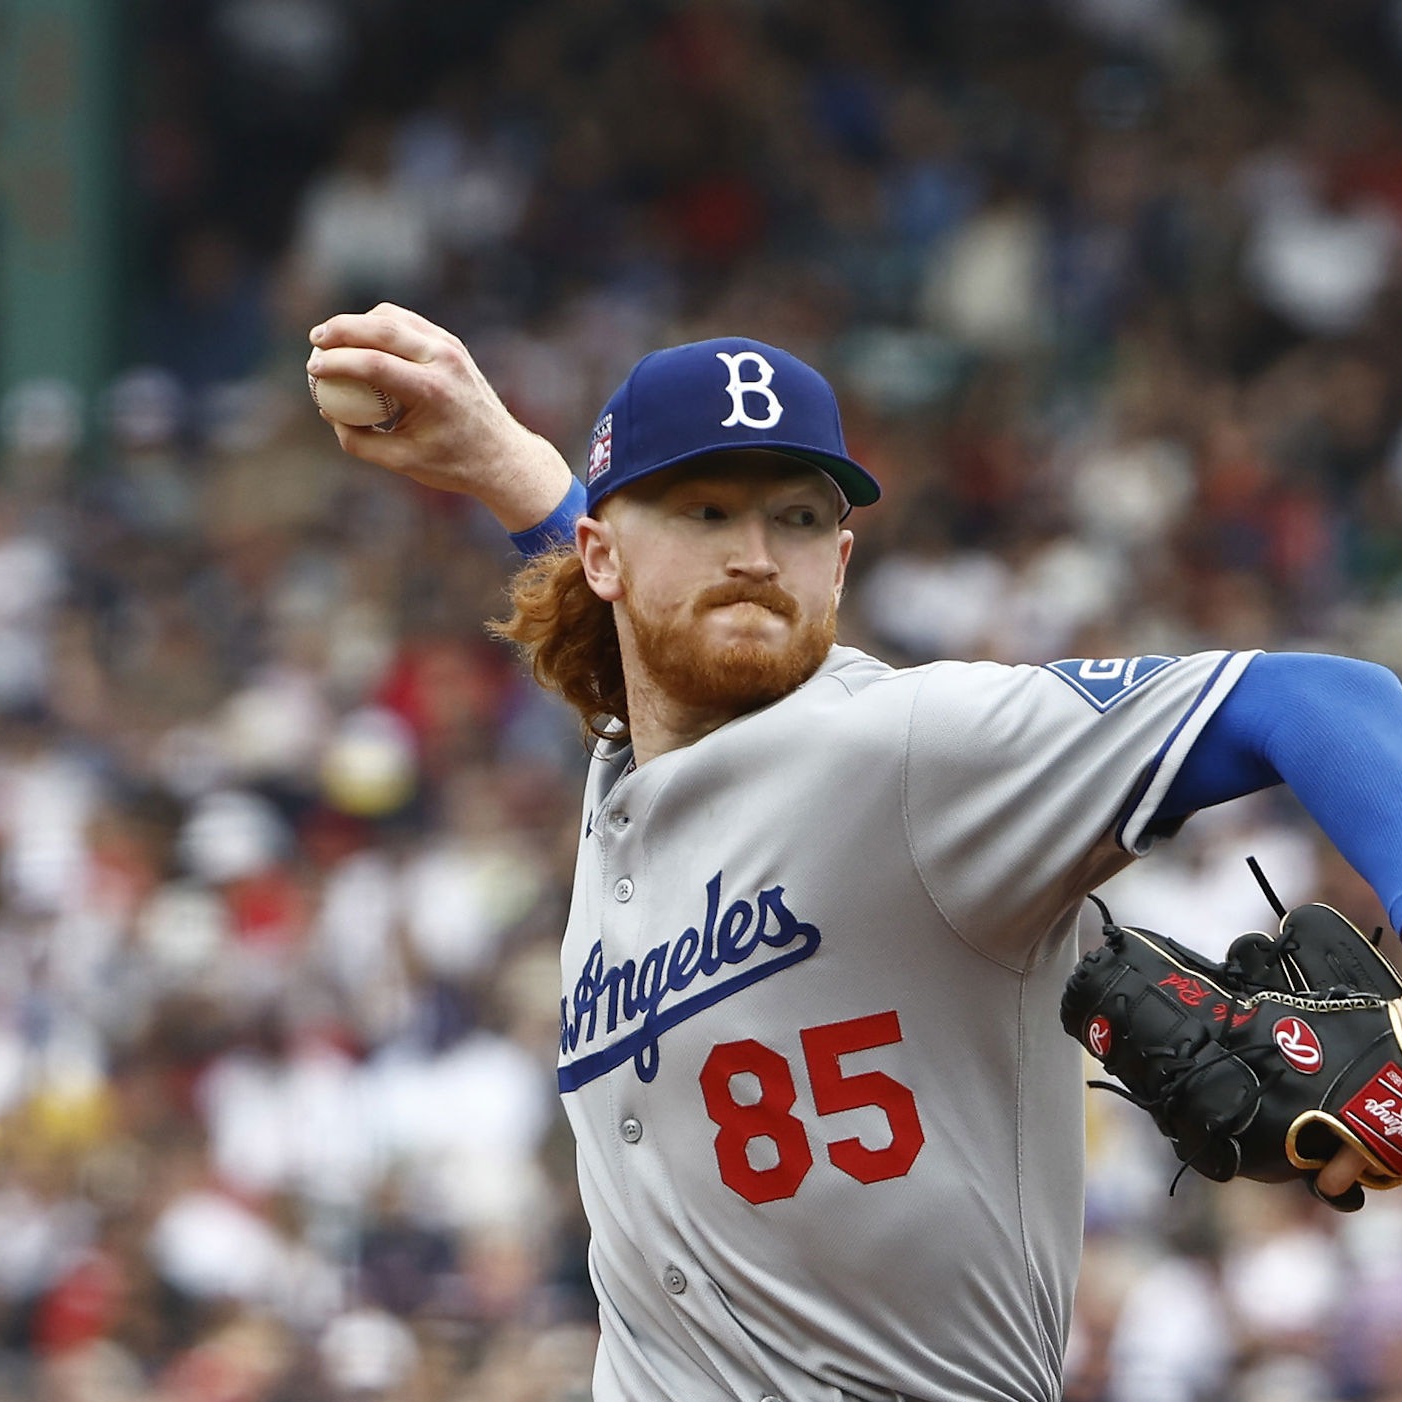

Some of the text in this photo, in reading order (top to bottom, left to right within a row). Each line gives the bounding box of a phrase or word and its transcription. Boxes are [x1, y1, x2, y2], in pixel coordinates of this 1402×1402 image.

[715, 351, 784, 430] B
[569, 870, 821, 1083] Angeles
[1158, 973, 1211, 1007] Red
[1274, 1017, 1322, 1066] R
[699, 1010, 925, 1205] 85
